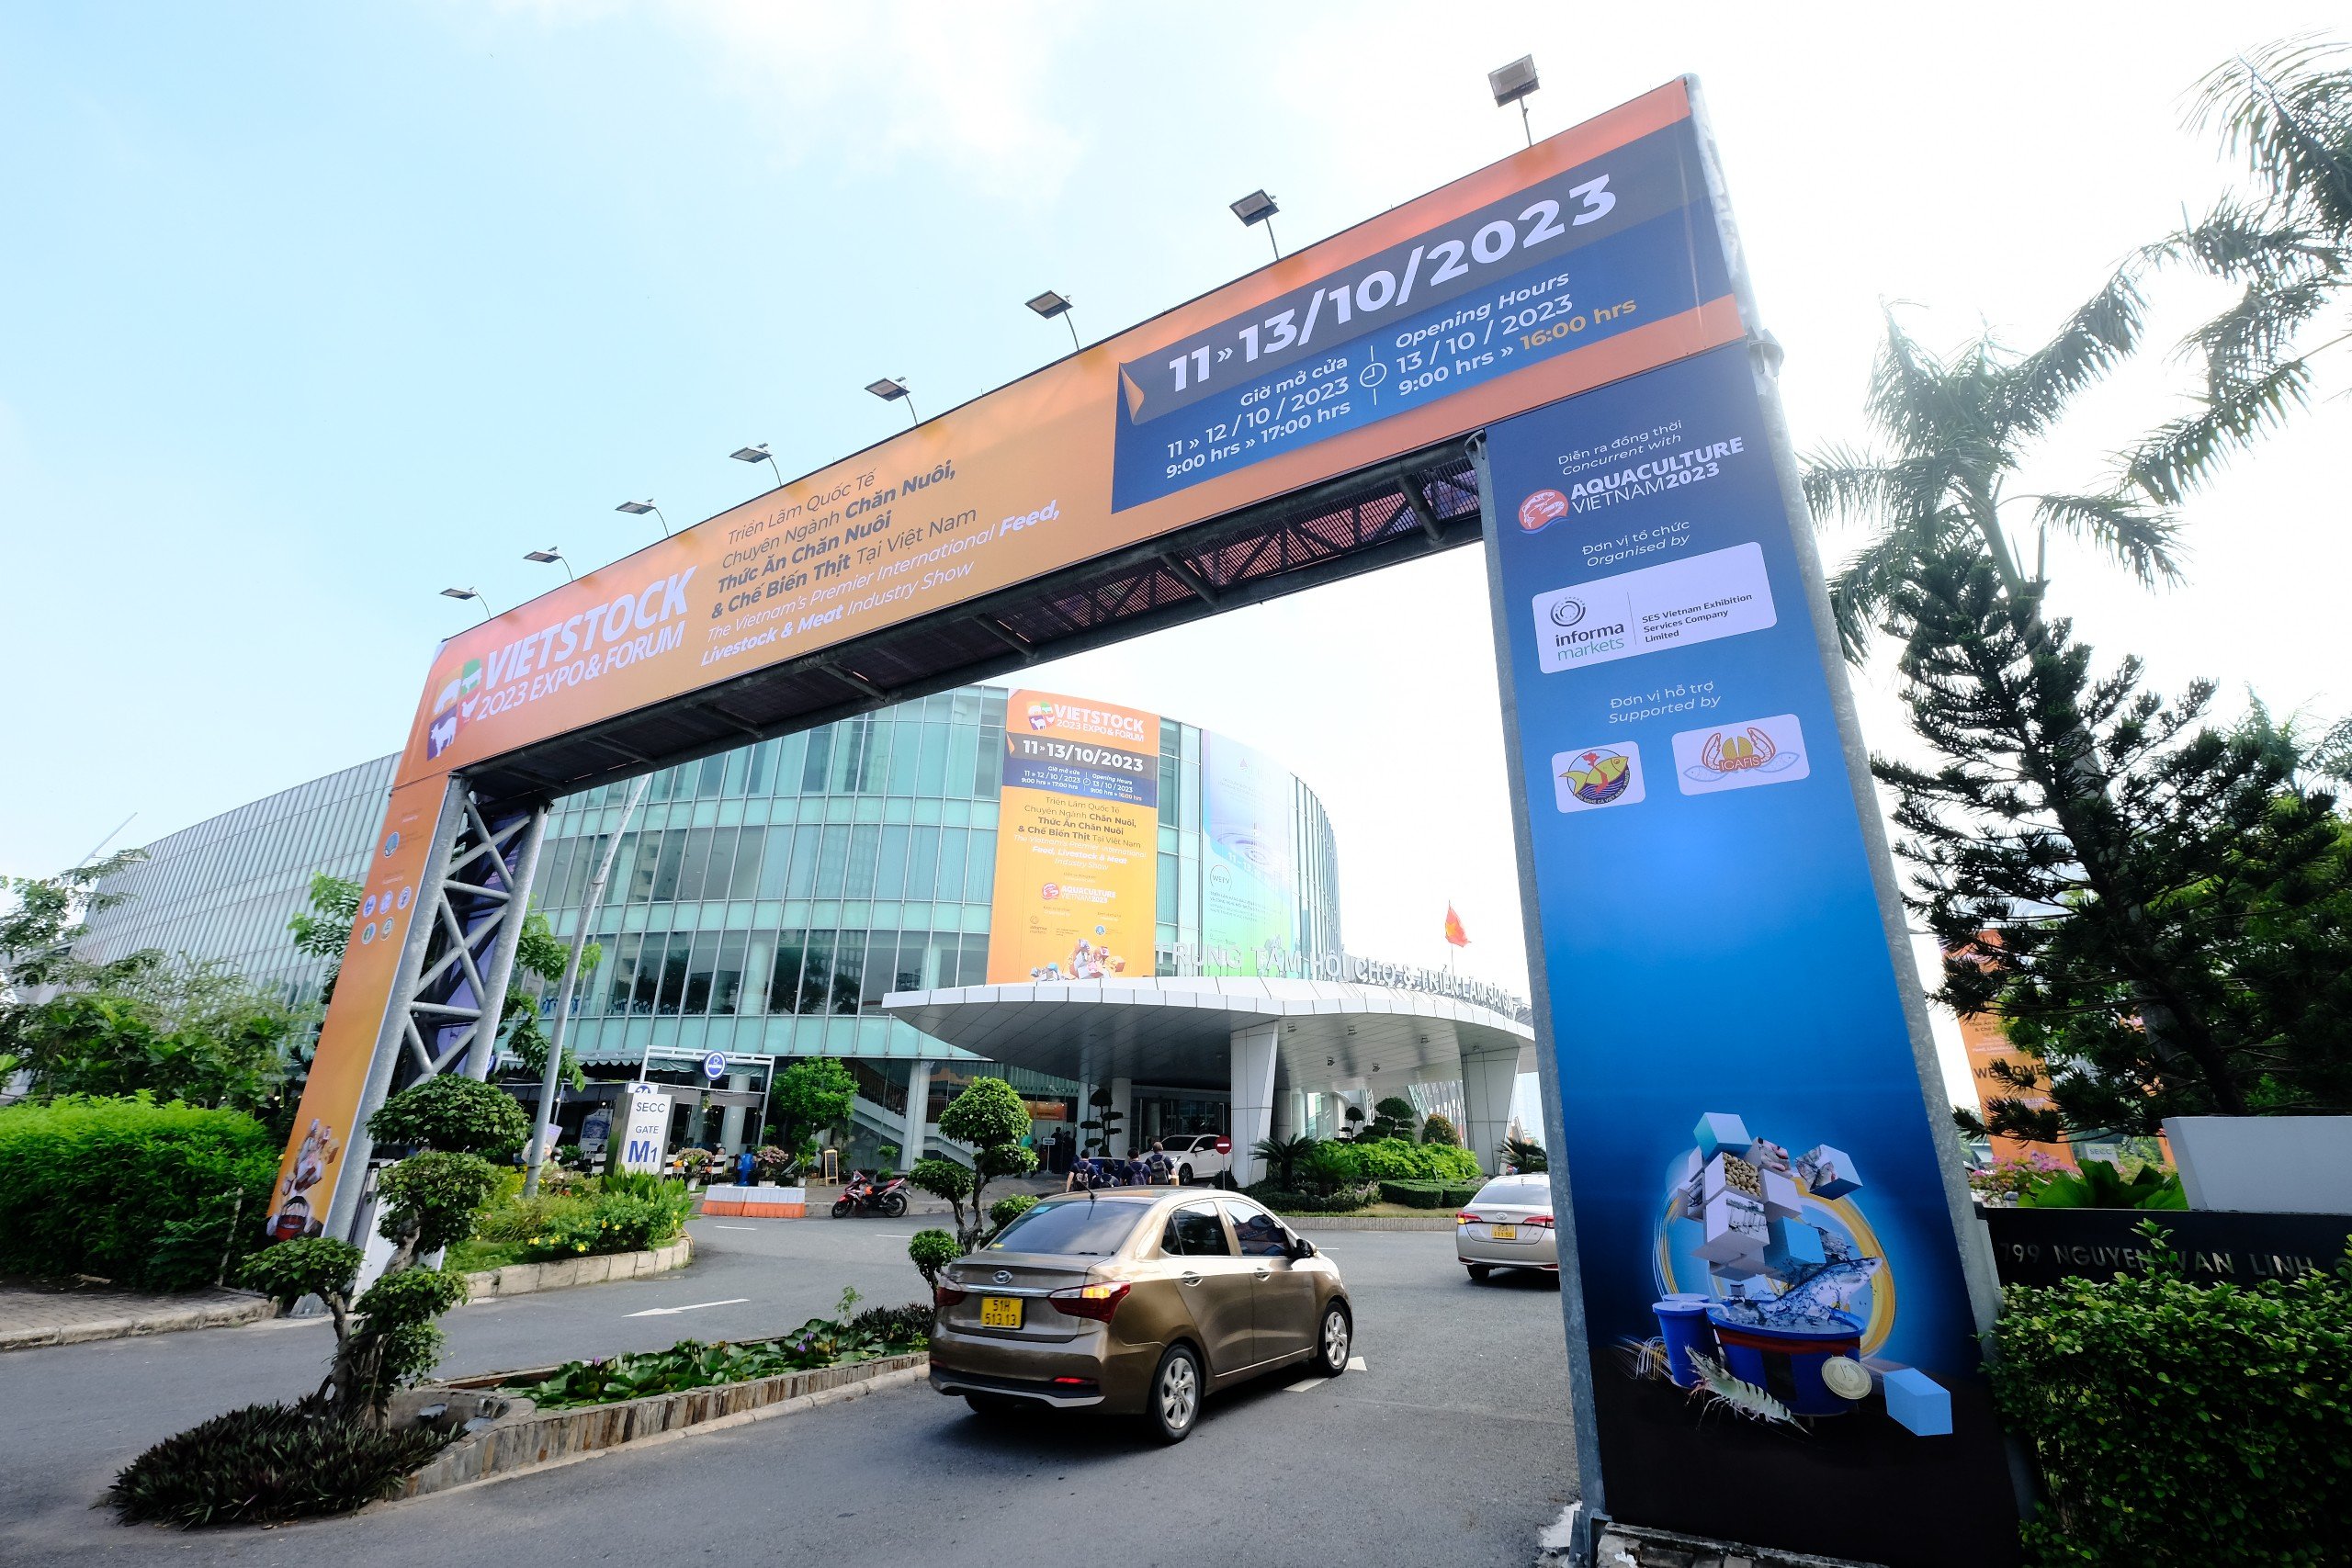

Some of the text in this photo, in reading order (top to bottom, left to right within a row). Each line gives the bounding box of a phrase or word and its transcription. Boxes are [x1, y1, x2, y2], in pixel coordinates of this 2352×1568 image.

[1170, 345, 1209, 391] 11
[1238, 174, 1617, 363] 13/10/2023
[1396, 273, 1568, 348] Opening Hours
[1501, 294, 1573, 335] 2023
[1398, 367, 1448, 395] 9:00
[1455, 350, 1494, 375] hrs
[1521, 316, 1586, 350] 16:00
[1594, 299, 1636, 324] hrs
[1241, 357, 1347, 406] Giờ mở cửa
[1168, 440, 1182, 458] 11
[1291, 377, 1349, 412] 2023
[1167, 454, 1204, 479] 9:00
[1211, 443, 1239, 462] hrs
[1261, 415, 1311, 443] 17:00
[1317, 402, 1350, 423] hrs
[1558, 420, 1682, 465] Diễn ra đồng thời
[1563, 434, 1681, 475] Concurrent with
[1571, 436, 1744, 500] AQUACULTURE
[723, 460, 956, 569] Chuyên Ngành Chăn Nuôi,
[729, 468, 877, 545] Triển Lãm Quốc Tế
[718, 510, 891, 593] Thức Ăn Chăn Nuôi
[1582, 521, 1690, 555] Đơn vị tổ chức
[1587, 535, 1690, 567] Organised by
[708, 500, 1060, 642] The Vietnam's Premier International Feed,
[712, 509, 977, 619] & Chế Biến Thịt Tại Việt Nam
[701, 561, 974, 667] Livestock & Meat Industry Show
[1642, 594, 1753, 623] SES Vietnam Exhibition
[1644, 610, 1728, 633] Services Company
[484, 565, 697, 690] VIETSTOCK
[1555, 623, 1624, 647] informa
[1645, 630, 1679, 643] Limited
[1558, 637, 1624, 660] markets
[477, 681, 526, 721] 2023
[1609, 695, 1721, 724] Supported by
[1611, 681, 1713, 708] Đơn vị hỗ trợ
[1054, 704, 1144, 733] VIETSTOCK
[1057, 720, 1080, 729] 2023
[1023, 740, 1037, 754] 11
[1722, 756, 1760, 770] ICAFIS
[1124, 840, 1141, 849] Nam
[1061, 885, 1116, 898] AQUACULTURE
[1155, 942, 1241, 969] TRUNG
[636, 1102, 665, 1112] SECC
[628, 1140, 658, 1163] M1
